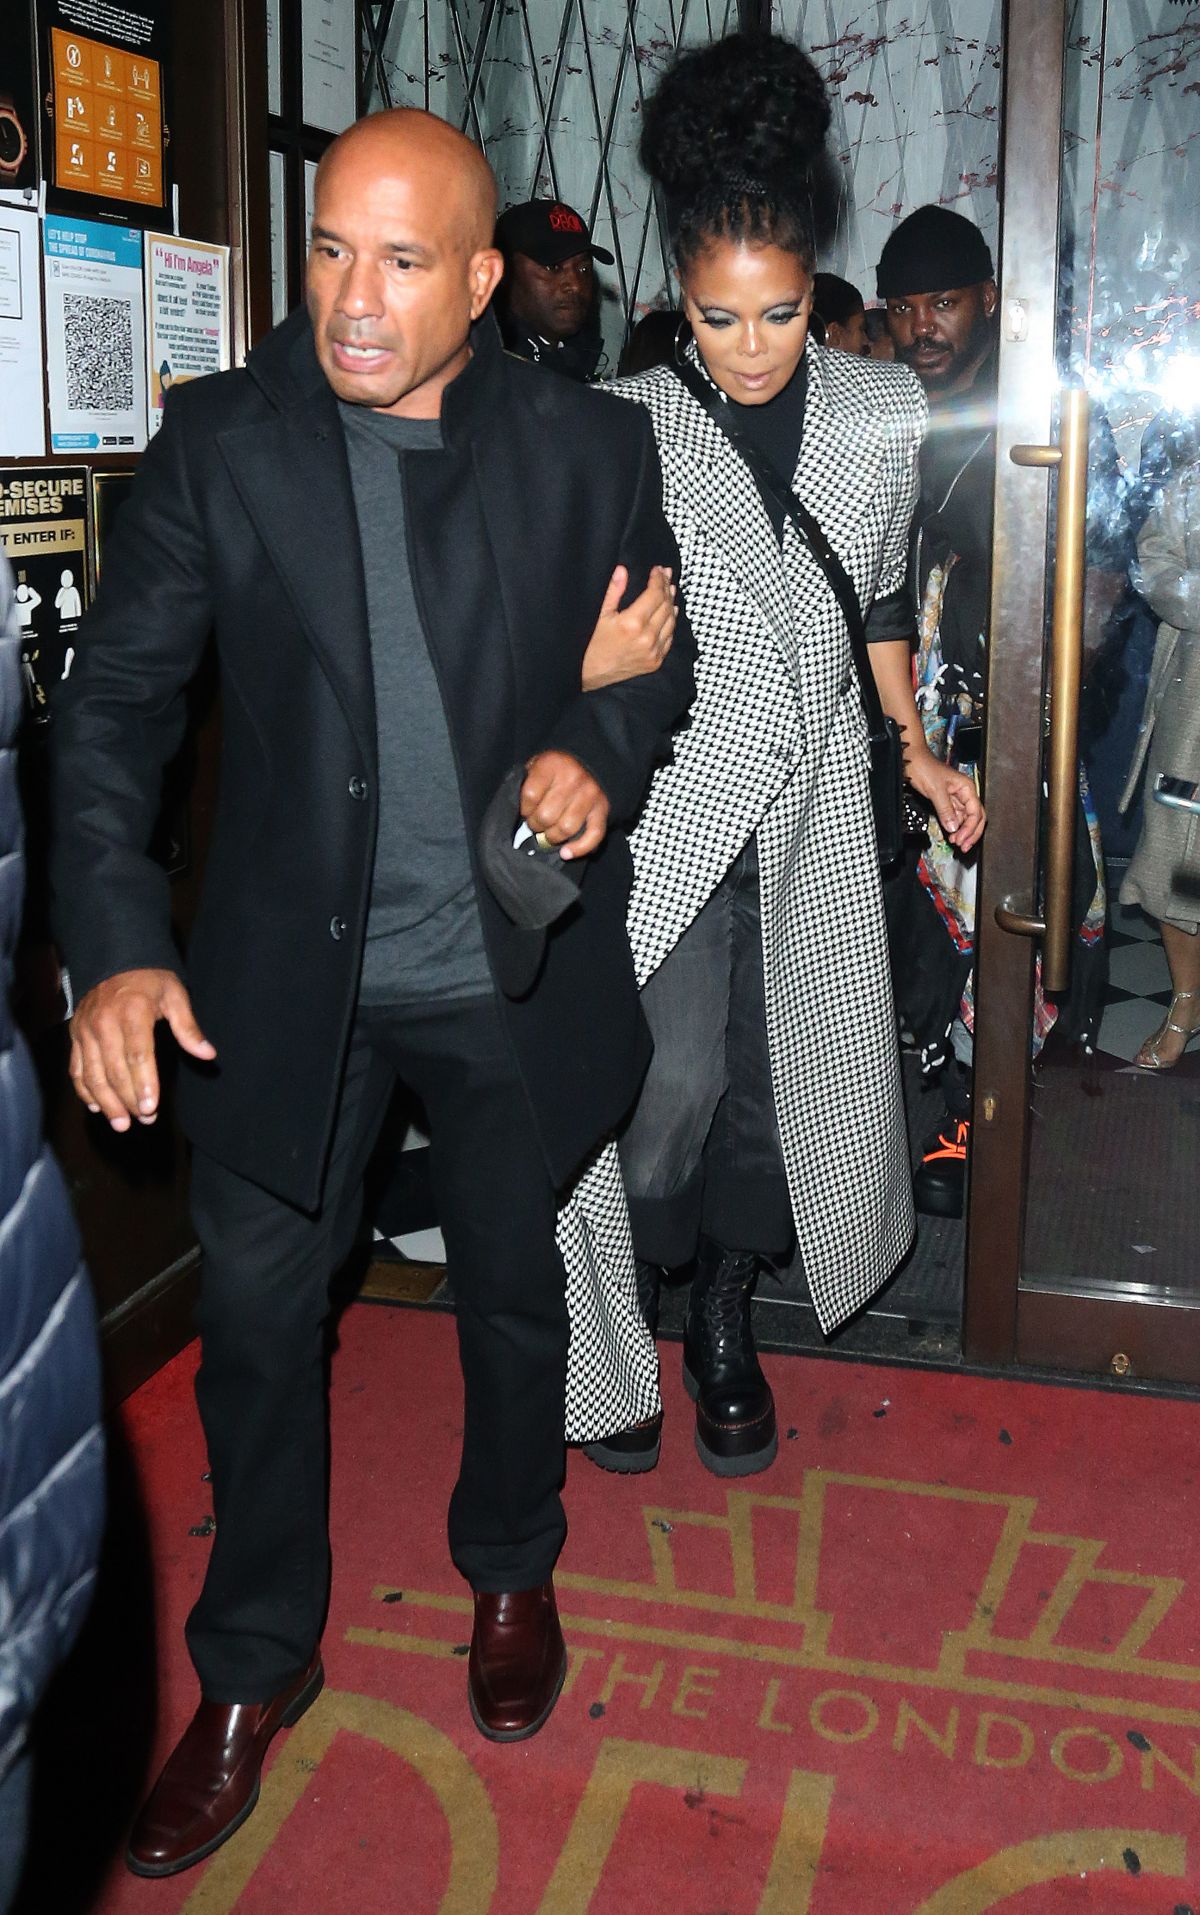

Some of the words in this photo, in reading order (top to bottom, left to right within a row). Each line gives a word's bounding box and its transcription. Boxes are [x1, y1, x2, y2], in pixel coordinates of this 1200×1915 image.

[174, 254, 186, 271] I'm
[14, 530, 56, 545] ENTER
[60, 528, 76, 541] IF:
[561, 1645, 720, 1719] THE
[756, 1678, 1200, 1795] LONDON
